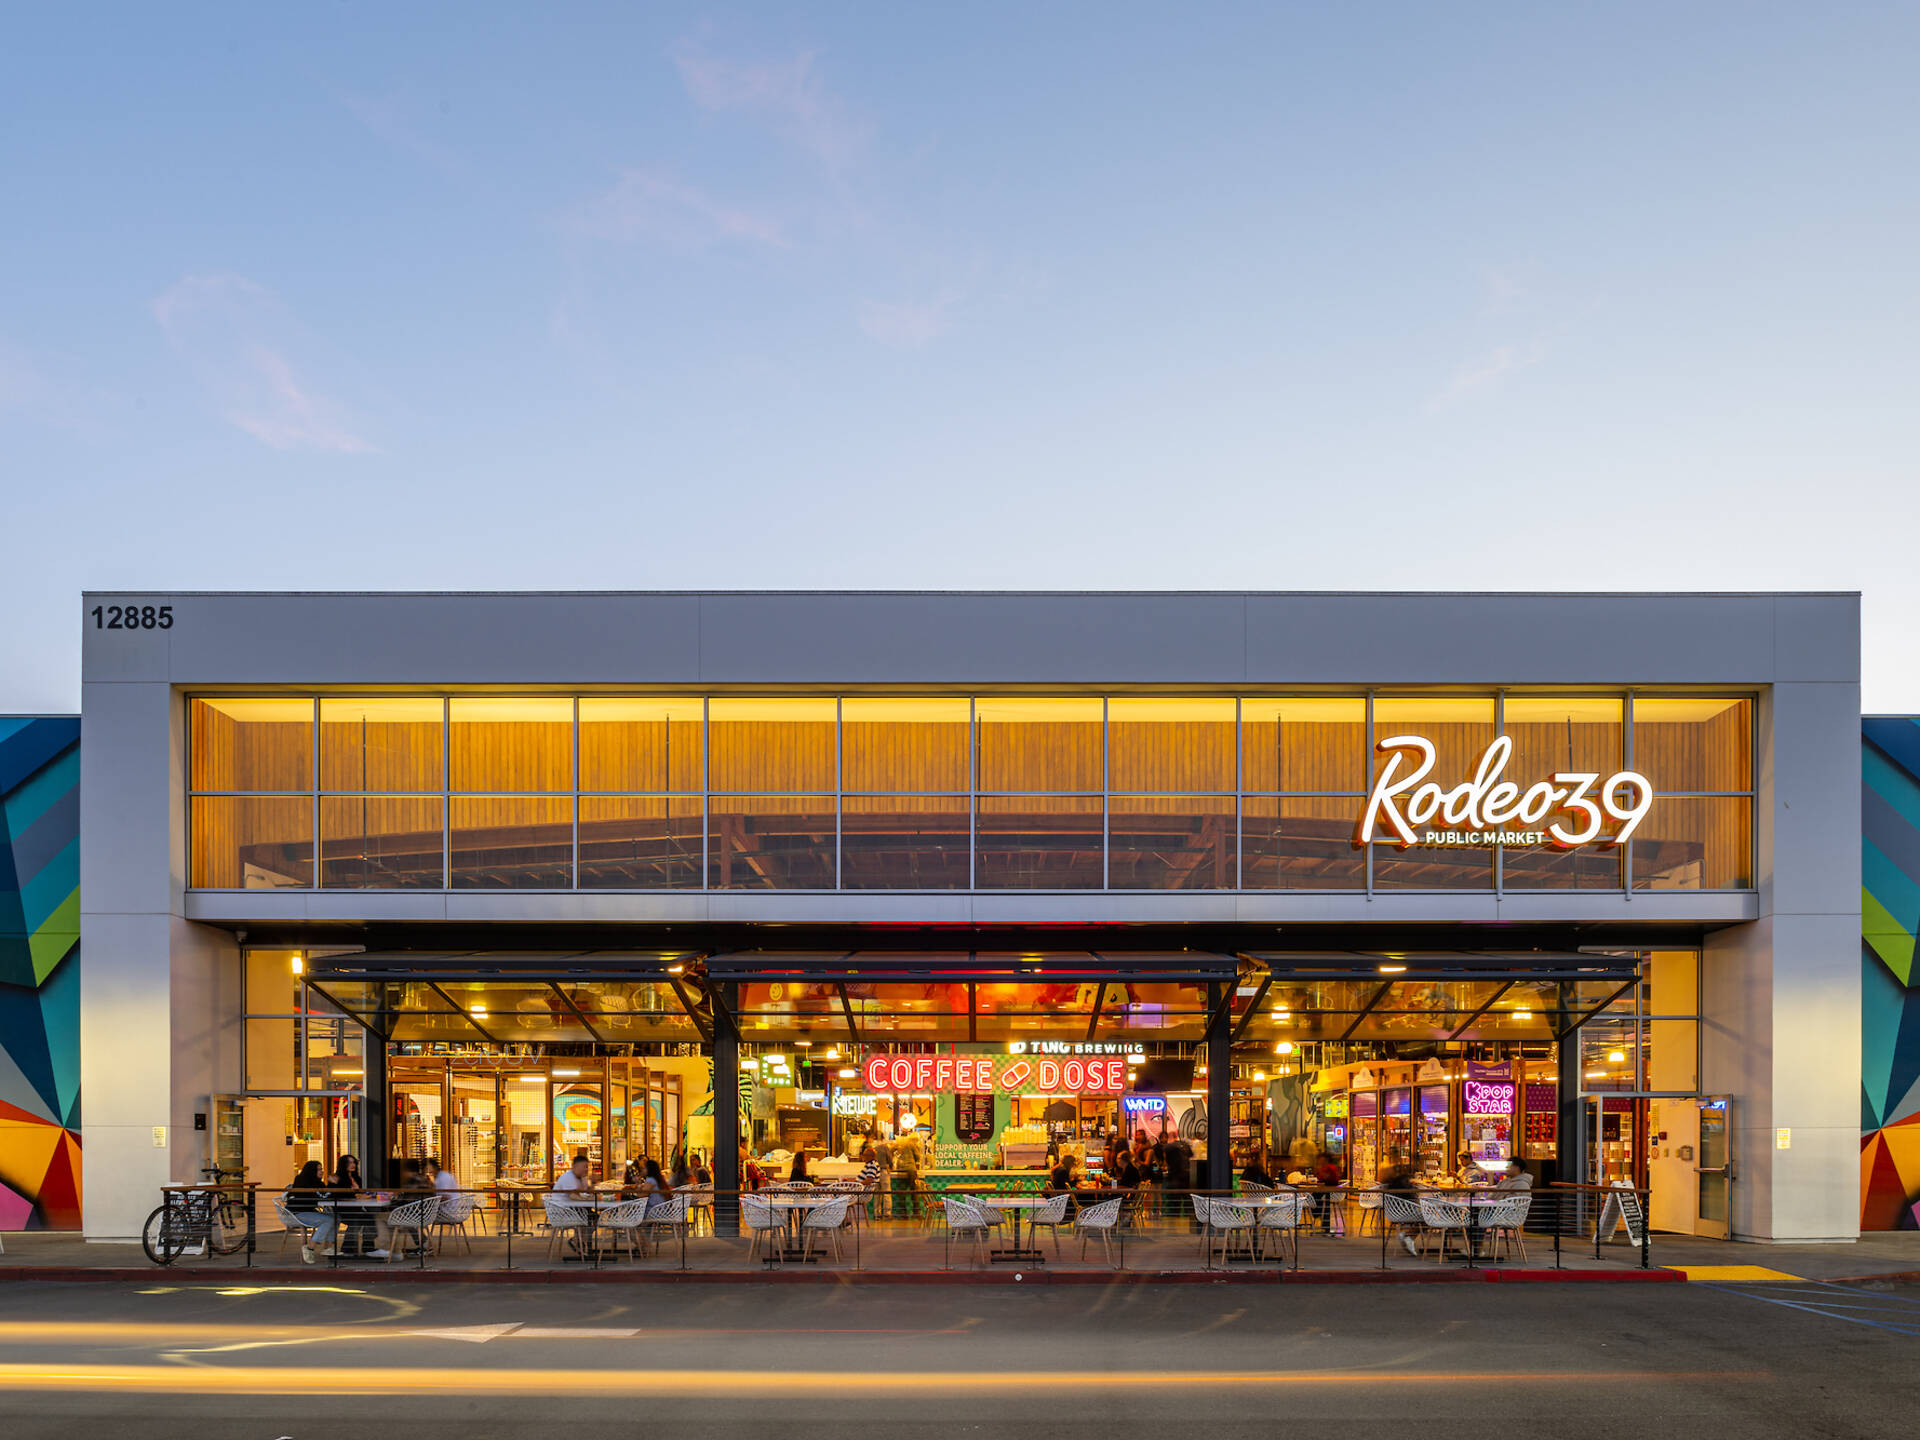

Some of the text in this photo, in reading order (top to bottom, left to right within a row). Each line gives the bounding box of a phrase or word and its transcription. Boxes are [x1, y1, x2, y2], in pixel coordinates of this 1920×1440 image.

[91, 606, 174, 630] 12885
[1426, 831, 1545, 845] PUBLIC MARKET
[1030, 1042, 1071, 1054] TANG
[869, 1059, 1125, 1090] COFFEE DOSE
[1468, 1100, 1512, 1113] STAR
[935, 1143, 988, 1151] SUPPORT YOUR
[935, 1151, 993, 1159] LOCAL CAFFEINE
